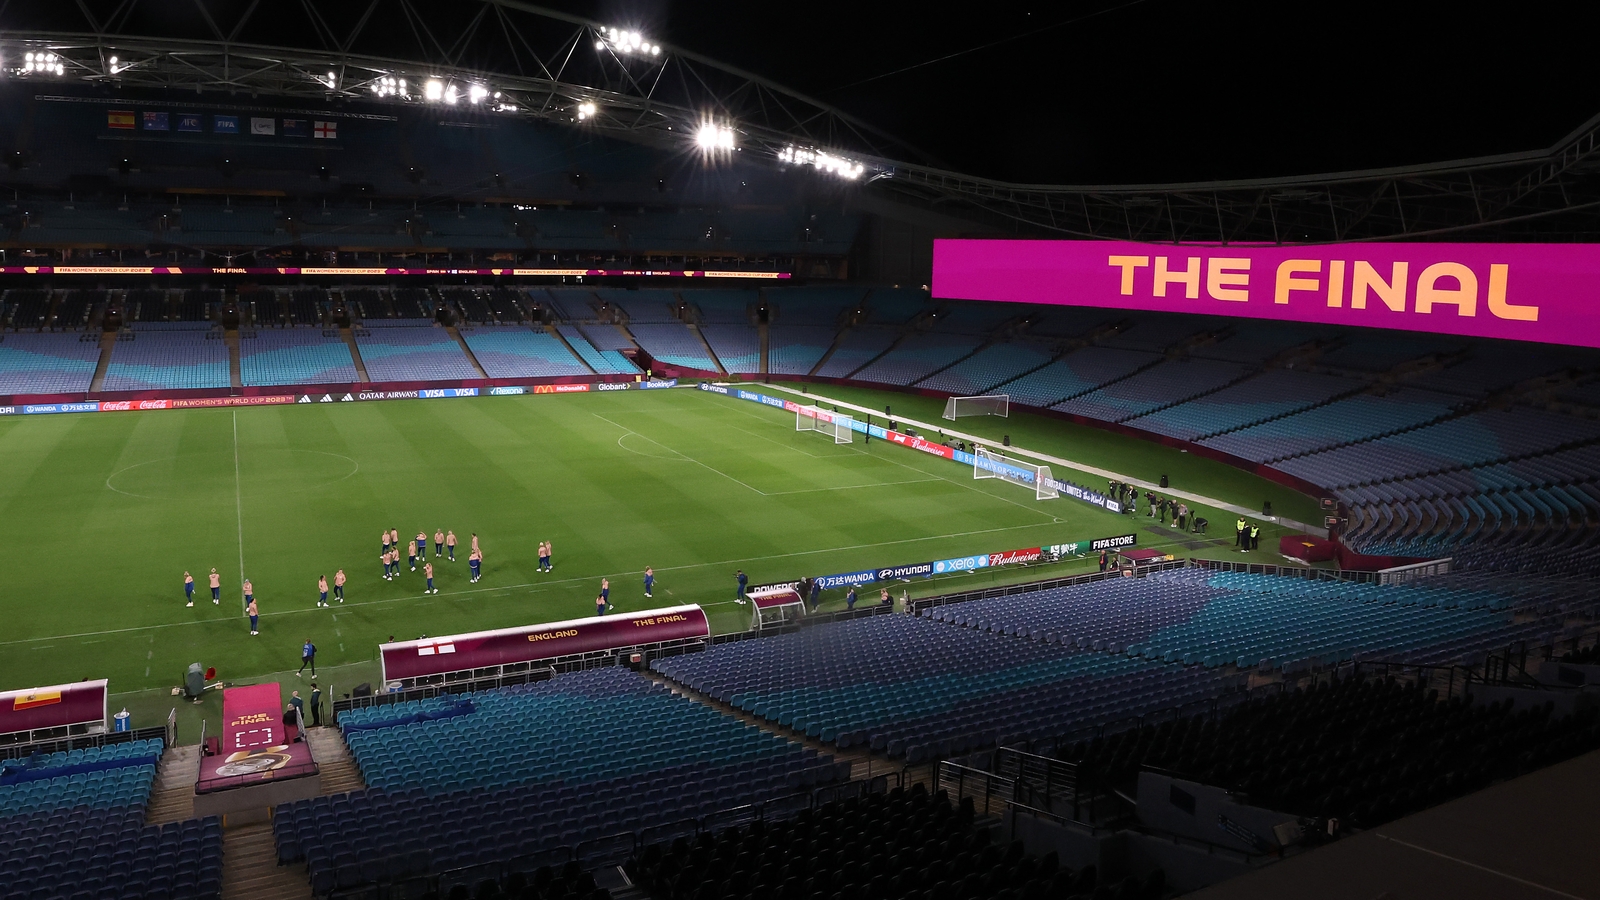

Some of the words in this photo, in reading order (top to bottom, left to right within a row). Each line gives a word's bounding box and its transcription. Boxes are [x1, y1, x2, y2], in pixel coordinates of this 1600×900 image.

[181, 118, 197, 127] AFC
[218, 120, 235, 128] FIFA
[1108, 255, 1251, 302] THE
[1274, 259, 1540, 322] FINAL
[424, 389, 445, 397] VISA
[454, 388, 475, 396] VISA
[496, 387, 523, 395] Rexona
[598, 382, 626, 391] Globant
[359, 392, 385, 400] QATAR
[386, 390, 418, 398] AIRWAYS
[911, 438, 944, 457] Budweiser
[1044, 478, 1066, 492] FOOTBALL
[1066, 484, 1082, 498] UNITES
[1093, 538, 1110, 550] FIFA
[1110, 535, 1134, 547] STORE
[948, 557, 975, 571] xero
[989, 551, 1040, 566] Budweiser
[894, 564, 931, 577] HYUNDAI
[632, 617, 655, 627] THE
[656, 613, 687, 625] FINAL
[527, 628, 578, 642] ENGLAND
[232, 717, 274, 726] FINAL
